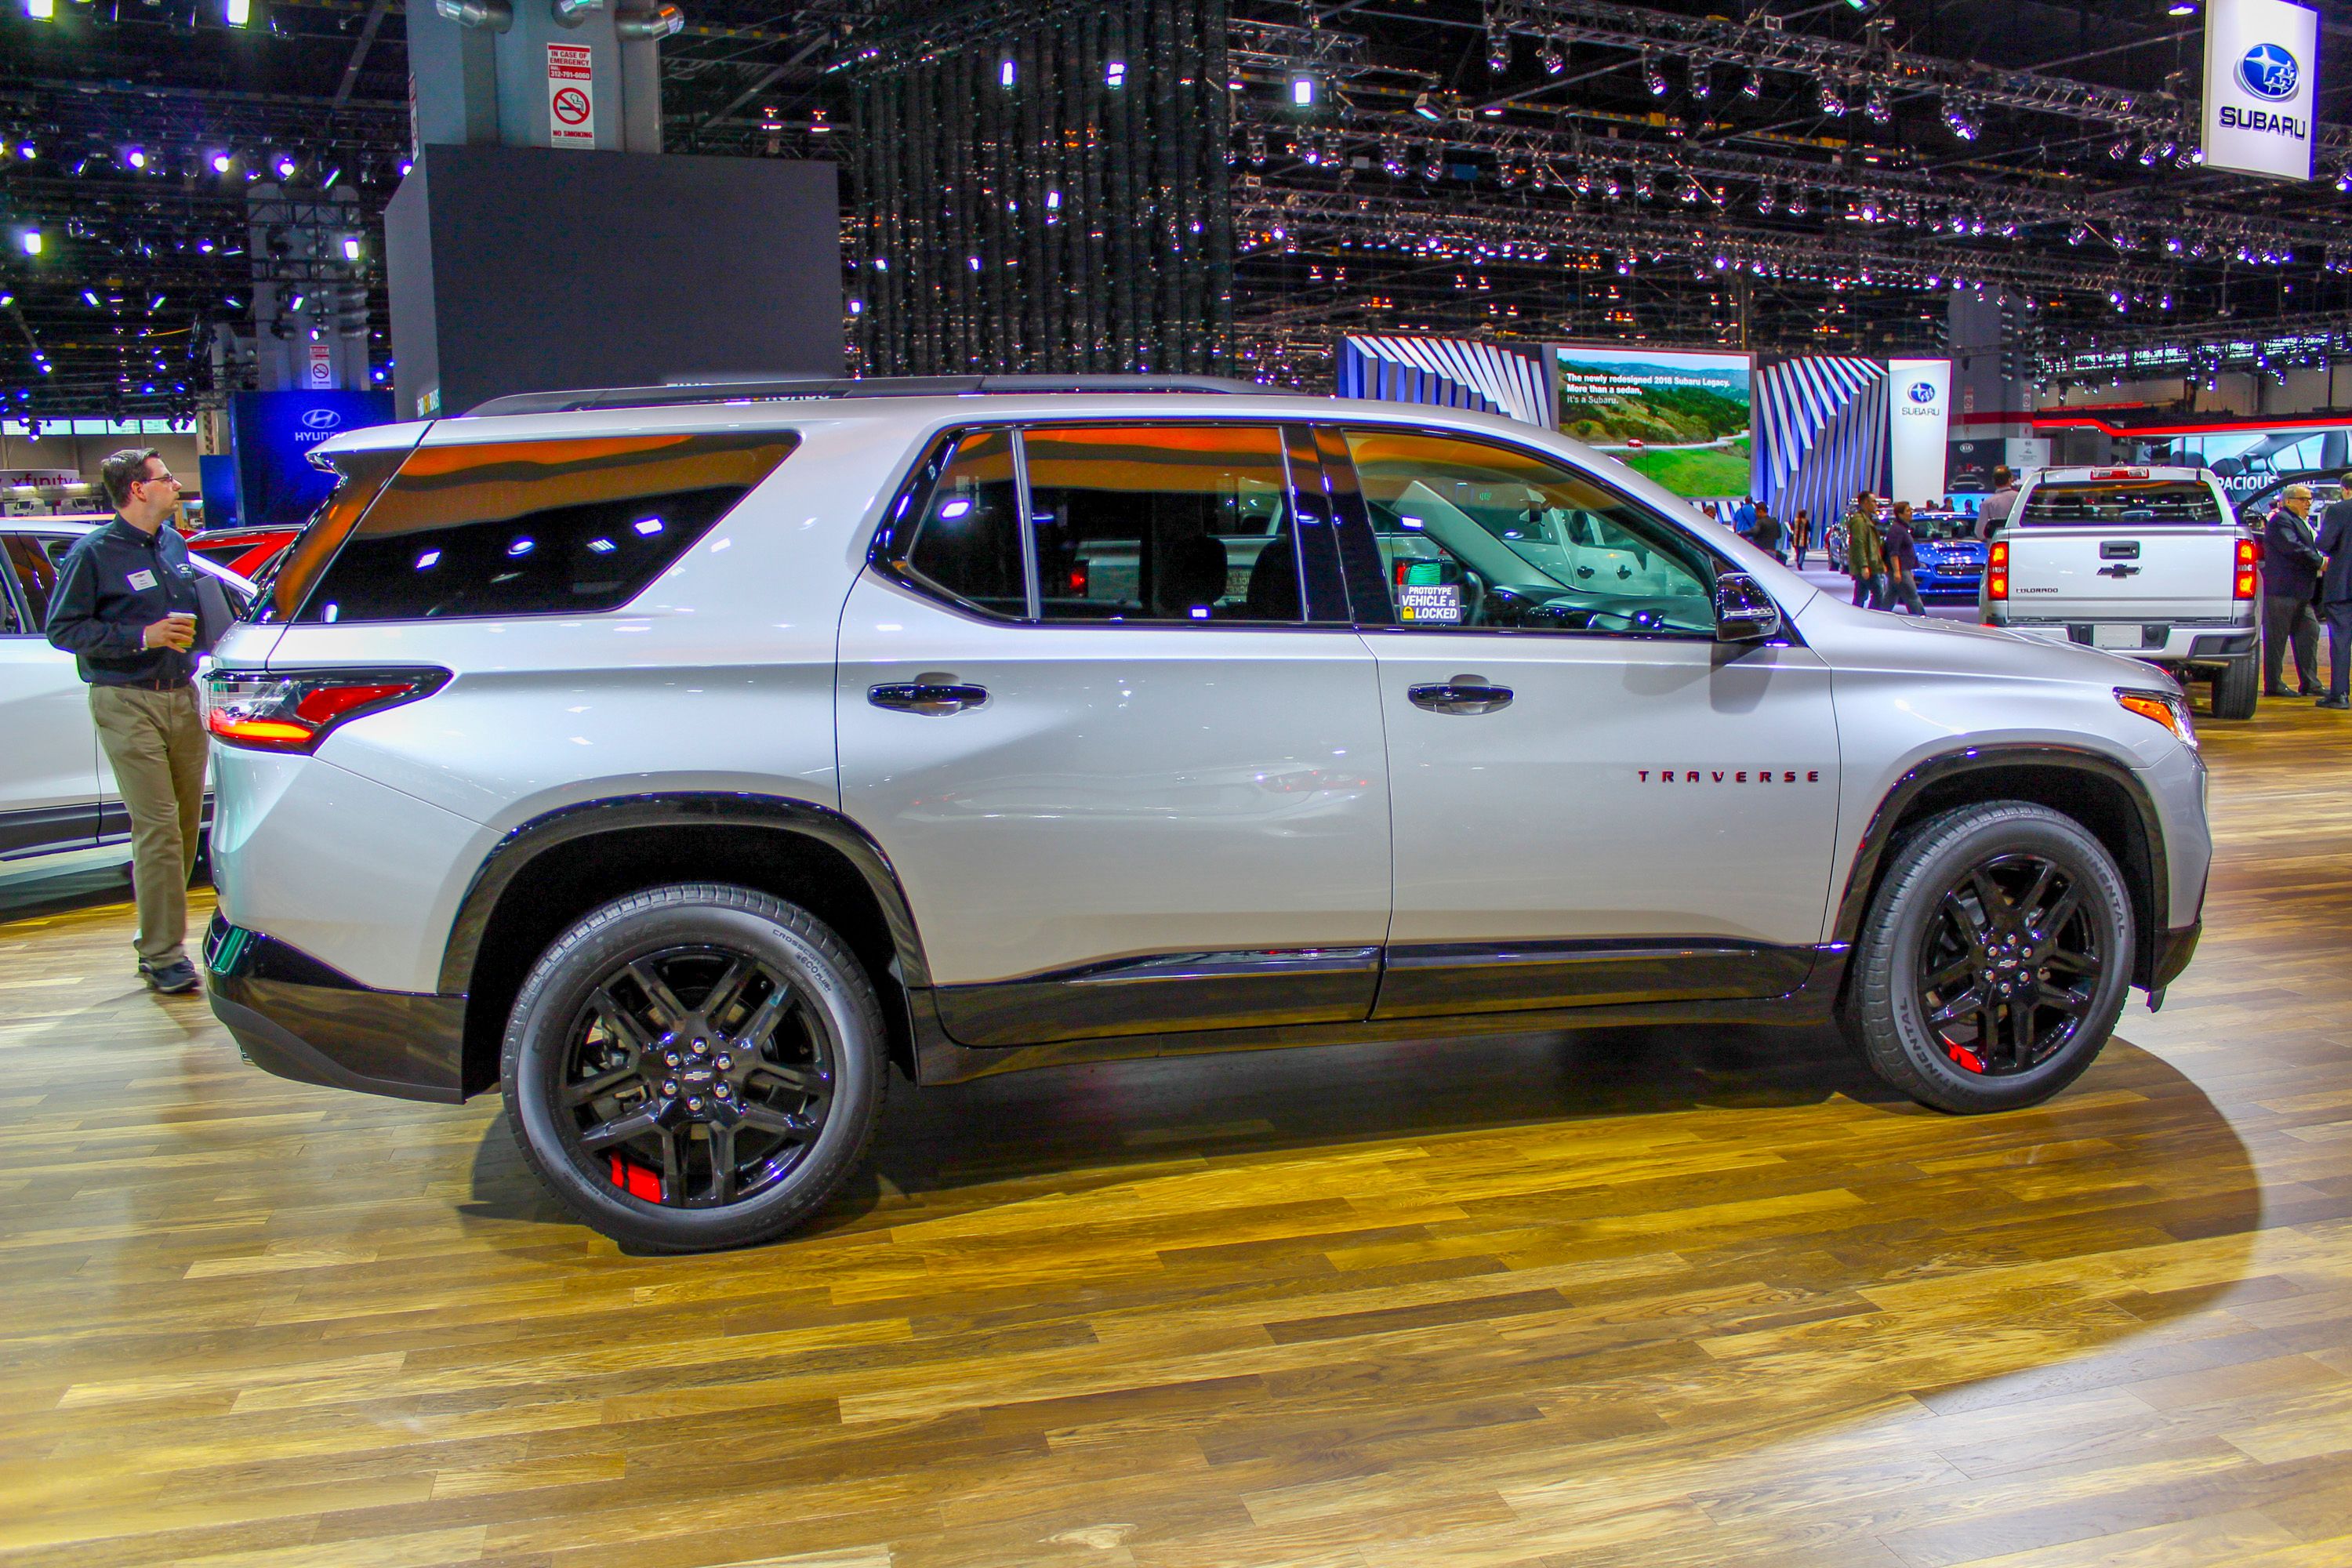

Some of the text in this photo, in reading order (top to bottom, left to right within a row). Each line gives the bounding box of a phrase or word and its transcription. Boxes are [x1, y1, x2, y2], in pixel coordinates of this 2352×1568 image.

[550, 57, 590, 66] EMERGENCY
[2220, 106, 2306, 140] SUBARU
[1566, 372, 1730, 388] The newly redesigned 2018 Subaru Legacy.
[1566, 383, 1588, 393] More
[1589, 384, 1607, 394] than
[1616, 386, 1642, 396] sedan,
[1567, 394, 1579, 403] it's
[1588, 395, 1619, 405] Subaru.
[1901, 407, 1940, 416] SUBARU
[295, 431, 336, 441] HYUN
[12, 473, 72, 485] xfinity
[2217, 475, 2278, 490] PACIOUS
[1409, 586, 1452, 595] PROTOTYPE
[1402, 595, 1447, 606] VEHICLE
[1415, 608, 1457, 619] LOCKED
[1639, 771, 1819, 782] TRAVERSE
